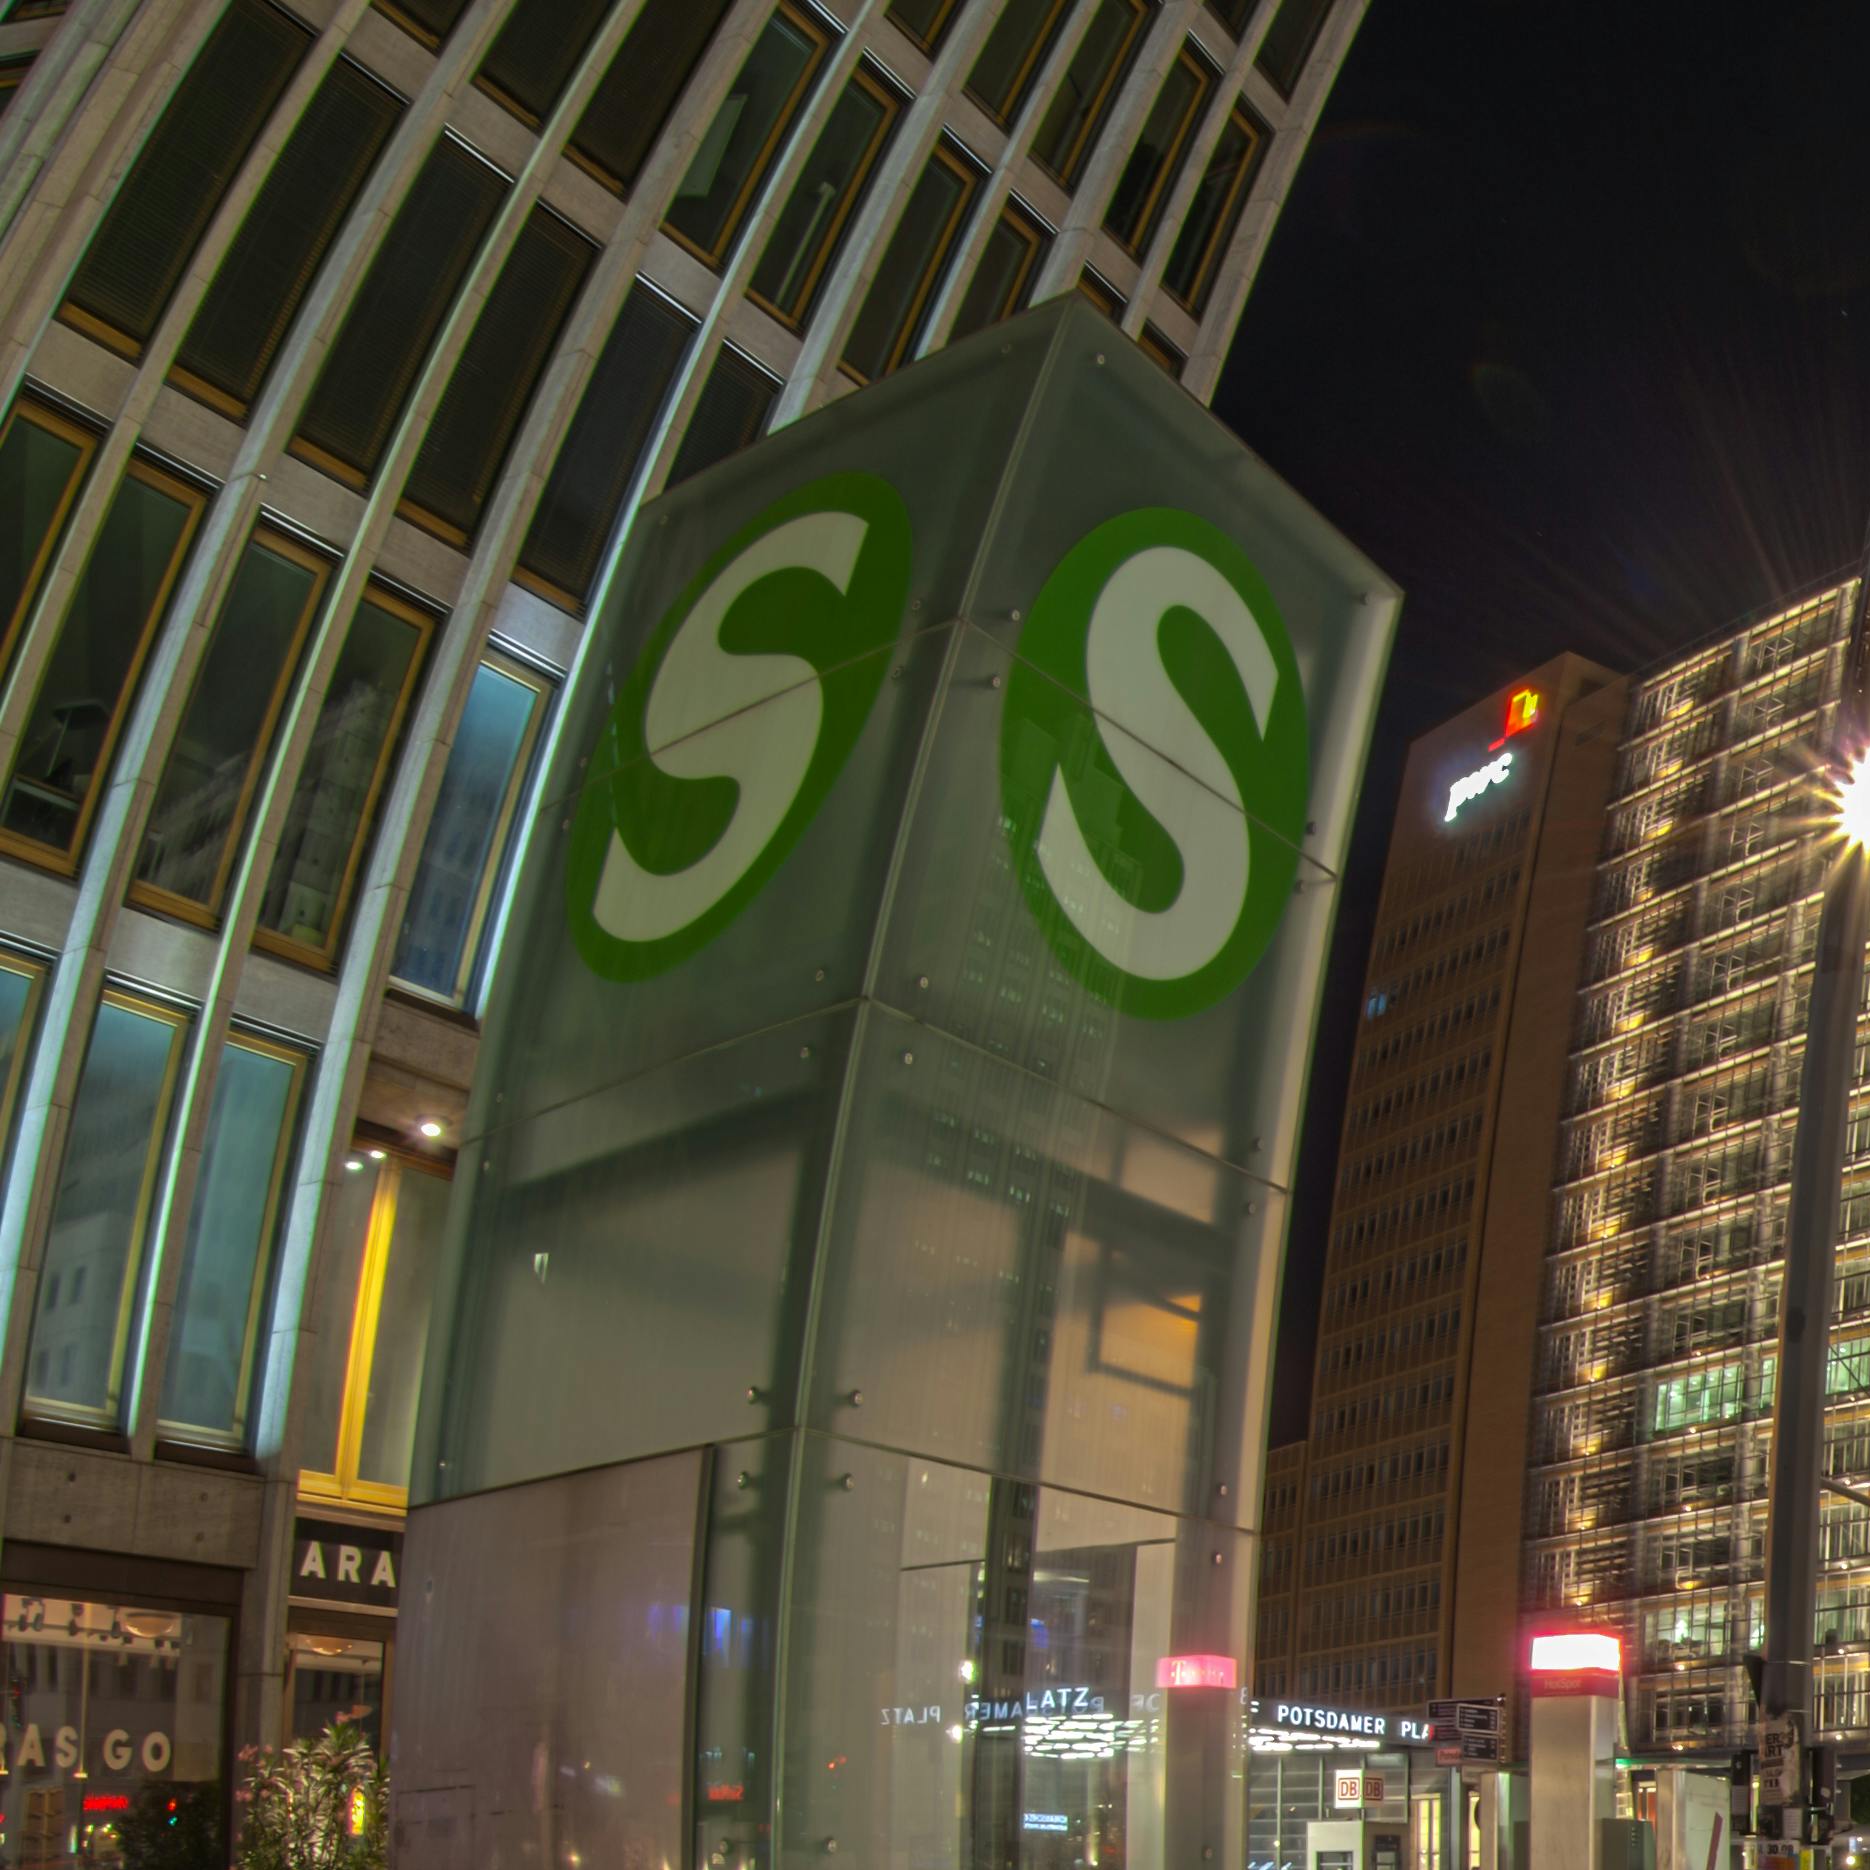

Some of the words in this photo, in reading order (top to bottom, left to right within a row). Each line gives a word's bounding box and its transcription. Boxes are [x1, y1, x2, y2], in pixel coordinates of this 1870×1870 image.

[593, 510, 869, 943] S
[1036, 545, 1279, 982] S
[301, 1541, 396, 1588] ARA
[1025, 1686, 1090, 1710] LATZ
[1277, 1704, 1386, 1735] POTSDAMER
[1401, 1720, 1432, 1741] PLA
[103, 1728, 172, 1772] GO
[1339, 1779, 1358, 1798] DB
[1364, 1779, 1382, 1798] DB
